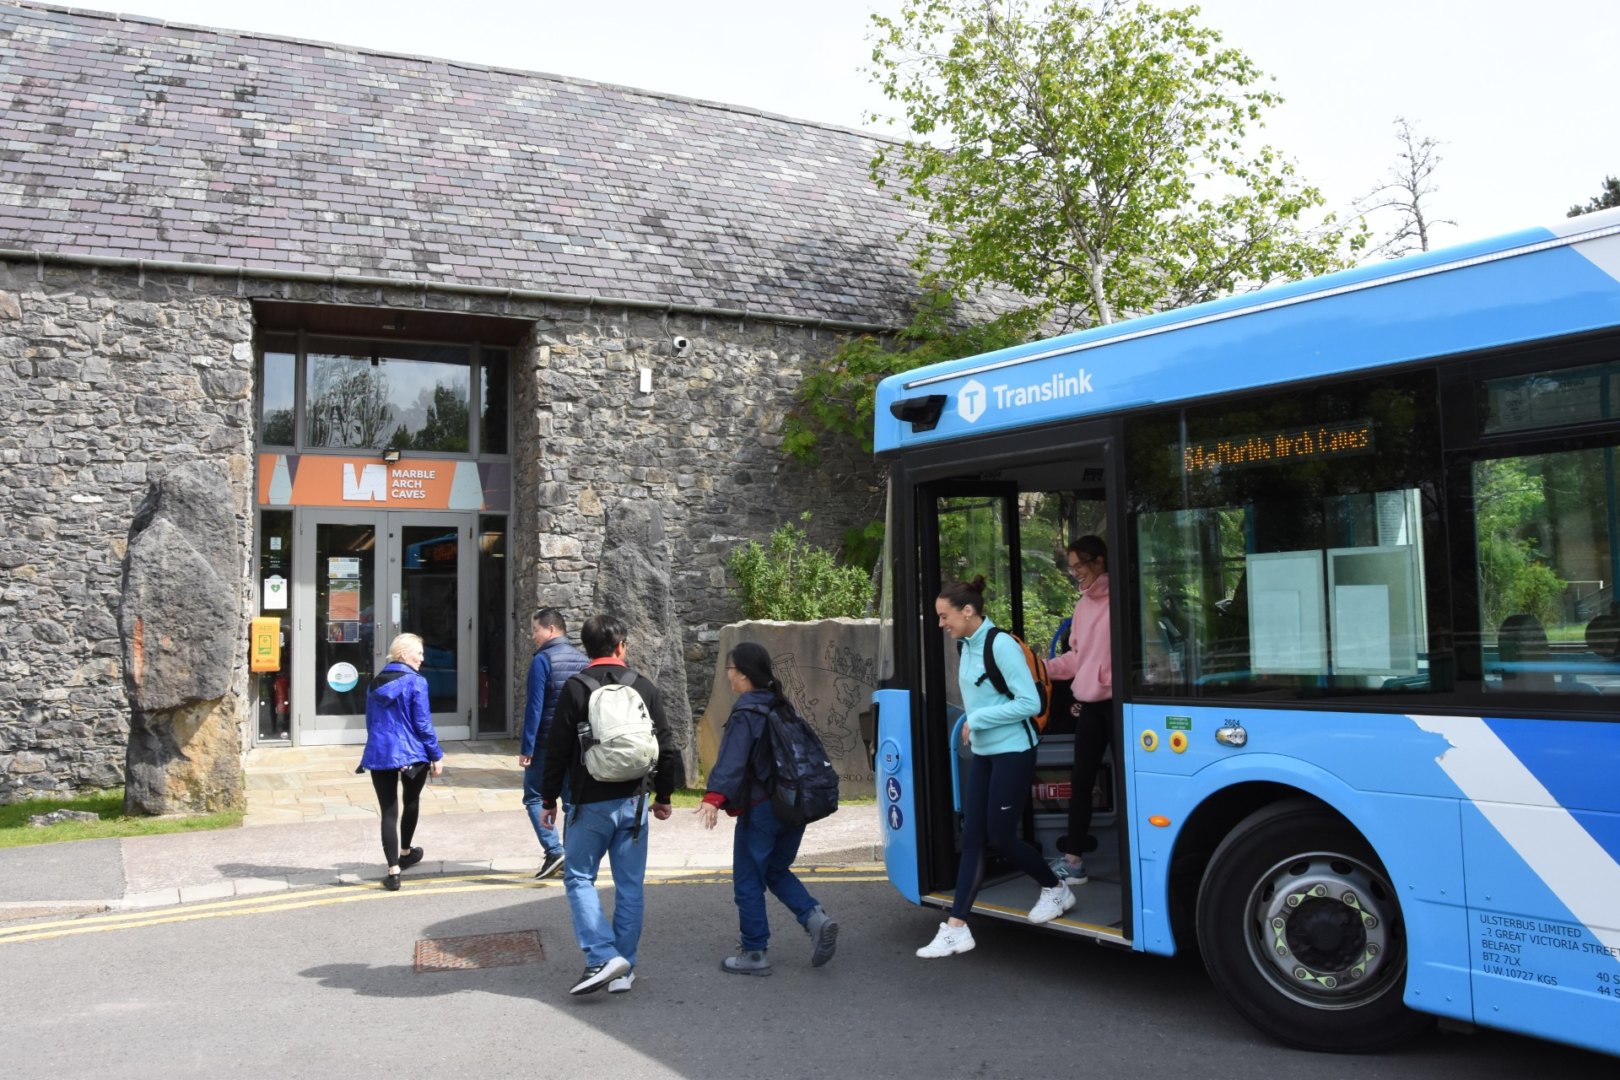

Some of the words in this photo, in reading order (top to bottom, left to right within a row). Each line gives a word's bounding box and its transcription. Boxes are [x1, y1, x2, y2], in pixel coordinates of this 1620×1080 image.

[992, 368, 1094, 410] Translink
[1217, 437, 1271, 465] Marble
[1276, 431, 1313, 458] Arch
[1318, 427, 1368, 452] Caves
[392, 469, 436, 479] MARBLE
[392, 479, 422, 489] ARCH
[391, 489, 426, 499] CAVES
[1480, 914, 1536, 931] ULSTERBUS
[1538, 922, 1582, 938] LIMITED
[1481, 939, 1522, 954] BELFAST
[1495, 928, 1528, 943] GREAT
[1529, 934, 1580, 951] VICTORIA
[1482, 951, 1500, 963] BT2
[1502, 954, 1521, 967] 7LX
[1537, 973, 1558, 986] KGS
[1596, 971, 1610, 983] 40
[1597, 985, 1611, 996] 44
